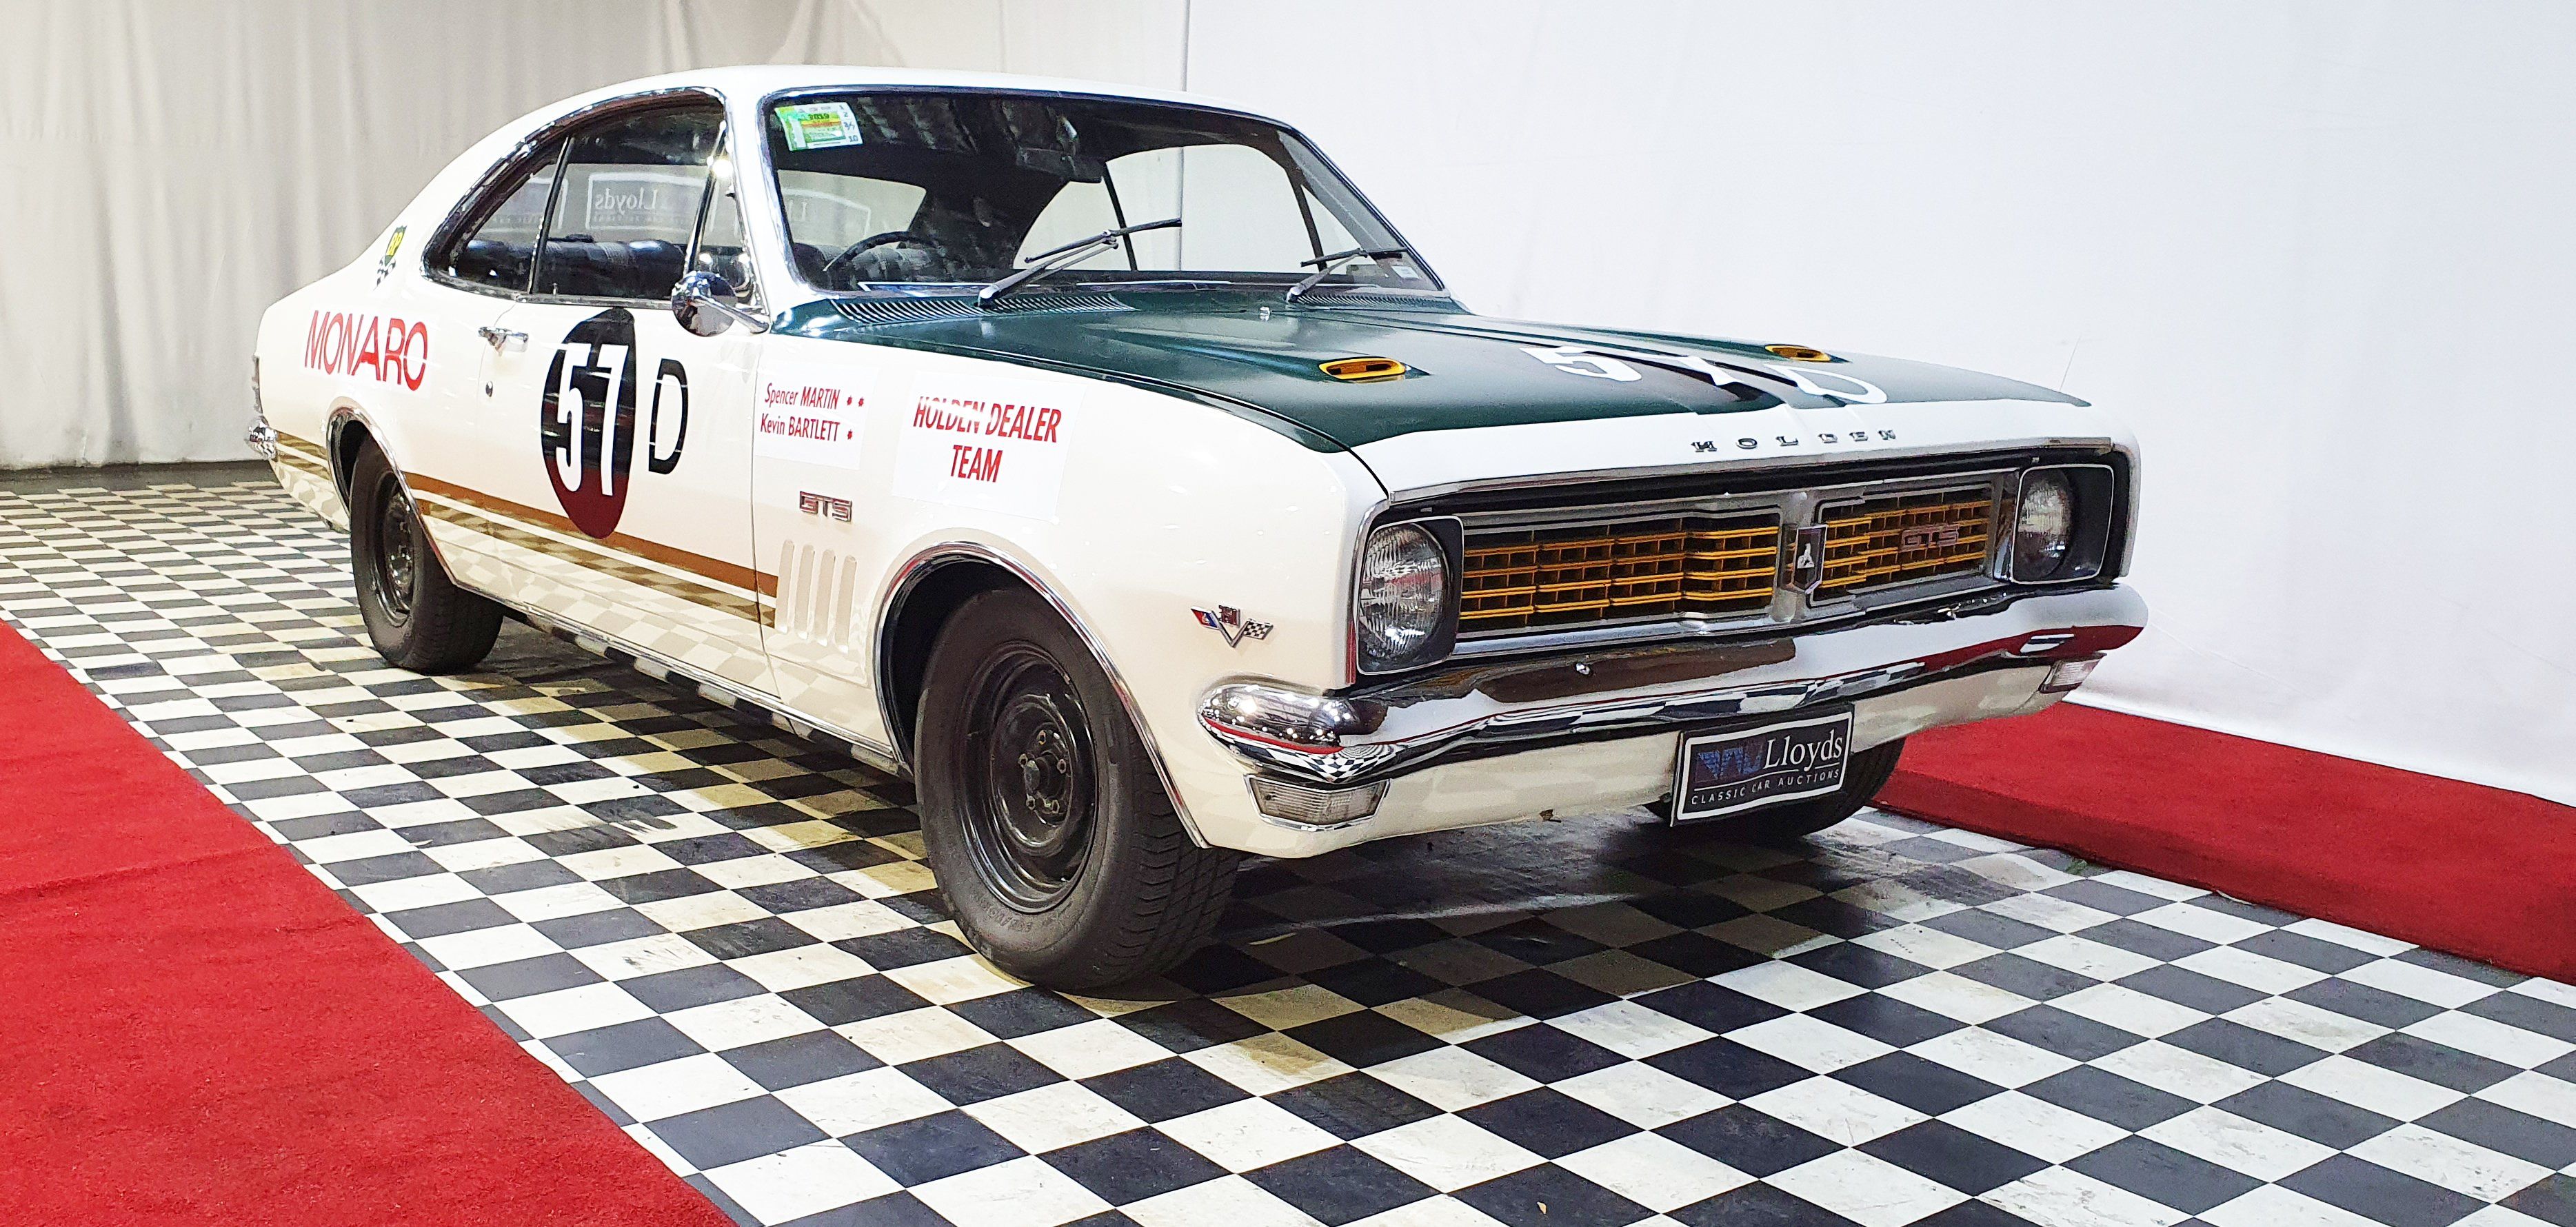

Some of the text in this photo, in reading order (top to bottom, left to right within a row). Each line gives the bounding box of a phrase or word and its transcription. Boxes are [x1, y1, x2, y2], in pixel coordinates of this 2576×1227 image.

[305, 310, 427, 391] MONARO
[765, 383, 841, 410] Spencer MARTIN
[554, 343, 688, 496] 57 D
[761, 416, 841, 442] Kevin BARTLETT
[913, 396, 1062, 443] HOLDEN DEALER
[1691, 429, 1896, 452] HOLDEN
[951, 445, 1003, 483] TEAM
[799, 491, 853, 522] GTS
[1901, 524, 1959, 551] GTS
[1762, 729, 1843, 772] Lloyds
[1691, 768, 1840, 805] CLASSIC CAR AUCTIONS
